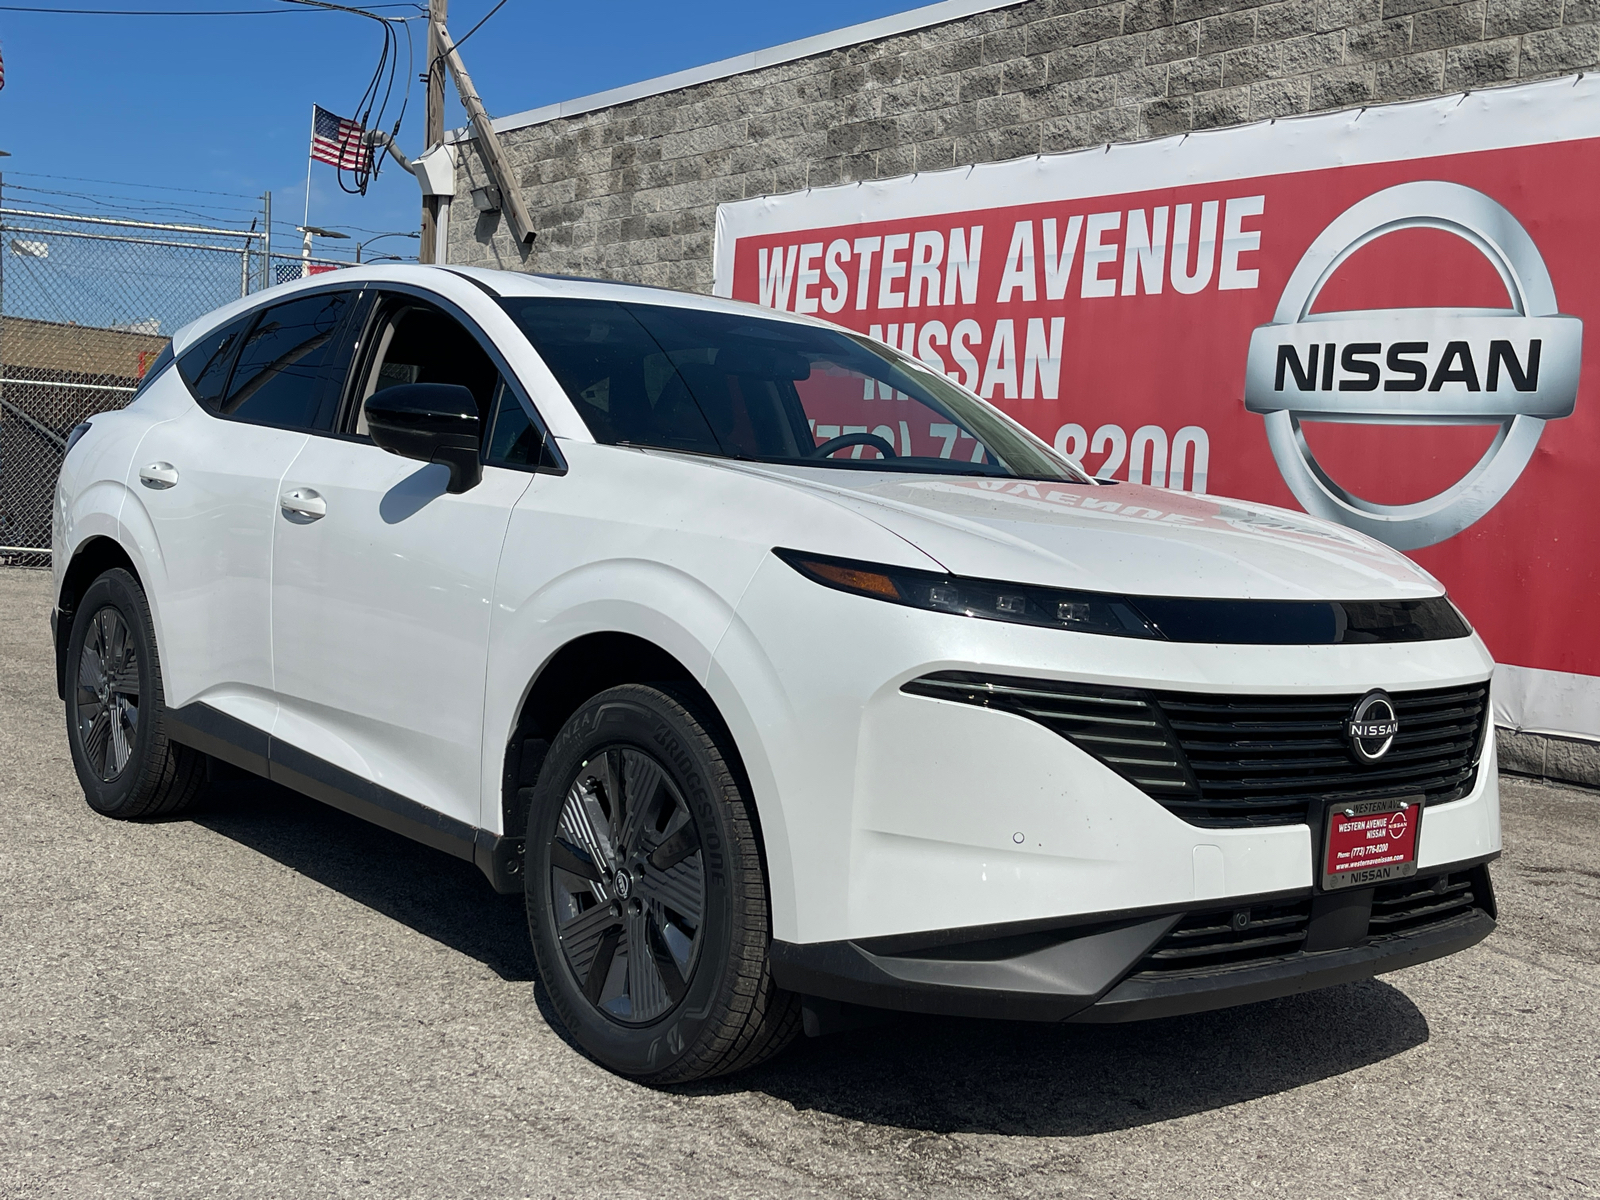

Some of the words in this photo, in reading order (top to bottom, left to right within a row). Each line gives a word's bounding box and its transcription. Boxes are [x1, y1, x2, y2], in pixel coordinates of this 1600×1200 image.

[757, 222, 984, 315] WESTERN
[997, 195, 1266, 305] AVENUE
[1276, 338, 1543, 394] NISSAN
[1350, 721, 1399, 737] NISSAN
[654, 722, 727, 889] BRIDGESTONE
[1353, 802, 1387, 814] WESTERN
[1338, 821, 1366, 832] WESTERN
[1366, 818, 1387, 829] AVENUE
[1366, 829, 1386, 839] NISSAN
[1351, 847, 1365, 859] (773)
[1365, 843, 1389, 855] 776-8200
[1336, 854, 1404, 870] www.westernavenissan.com
[1350, 867, 1391, 884] NISSAN
